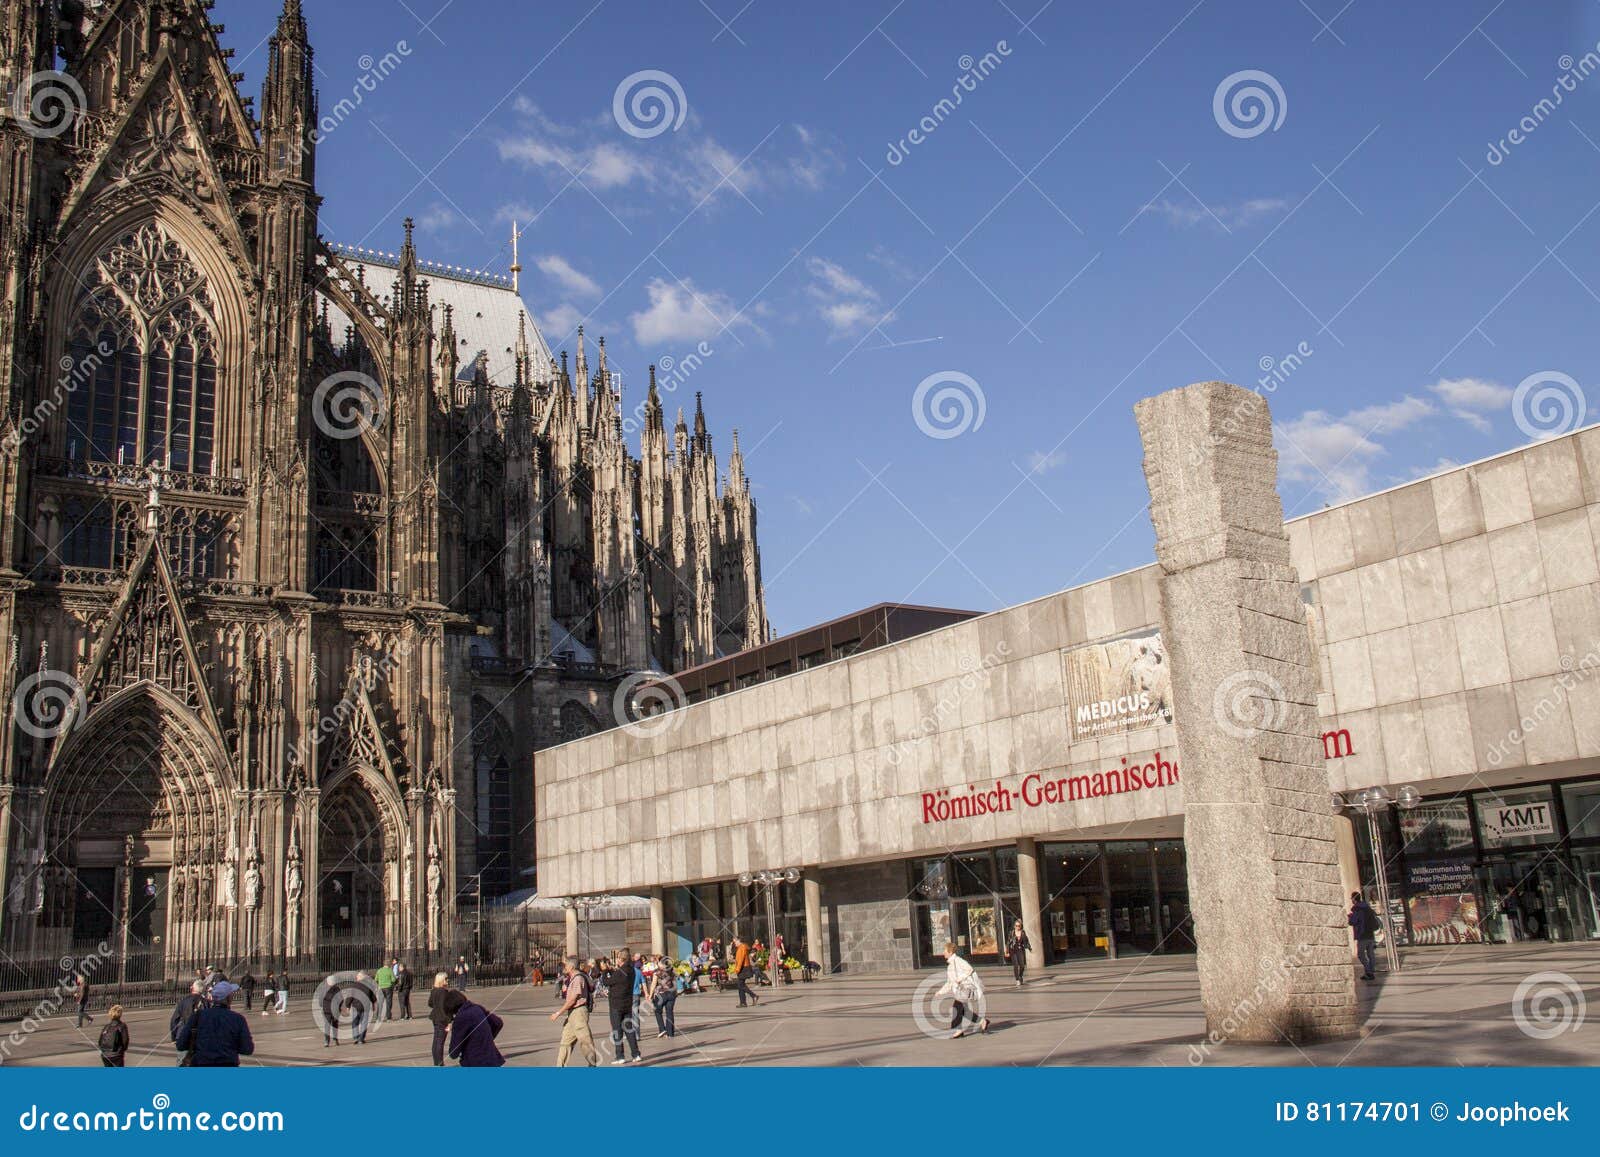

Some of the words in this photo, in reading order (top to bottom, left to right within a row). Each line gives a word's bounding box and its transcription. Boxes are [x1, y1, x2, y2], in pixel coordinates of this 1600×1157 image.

[1077, 692, 1150, 723] MEDICUS
[1092, 721, 1107, 732] Arzt
[1499, 805, 1546, 828] KMT
